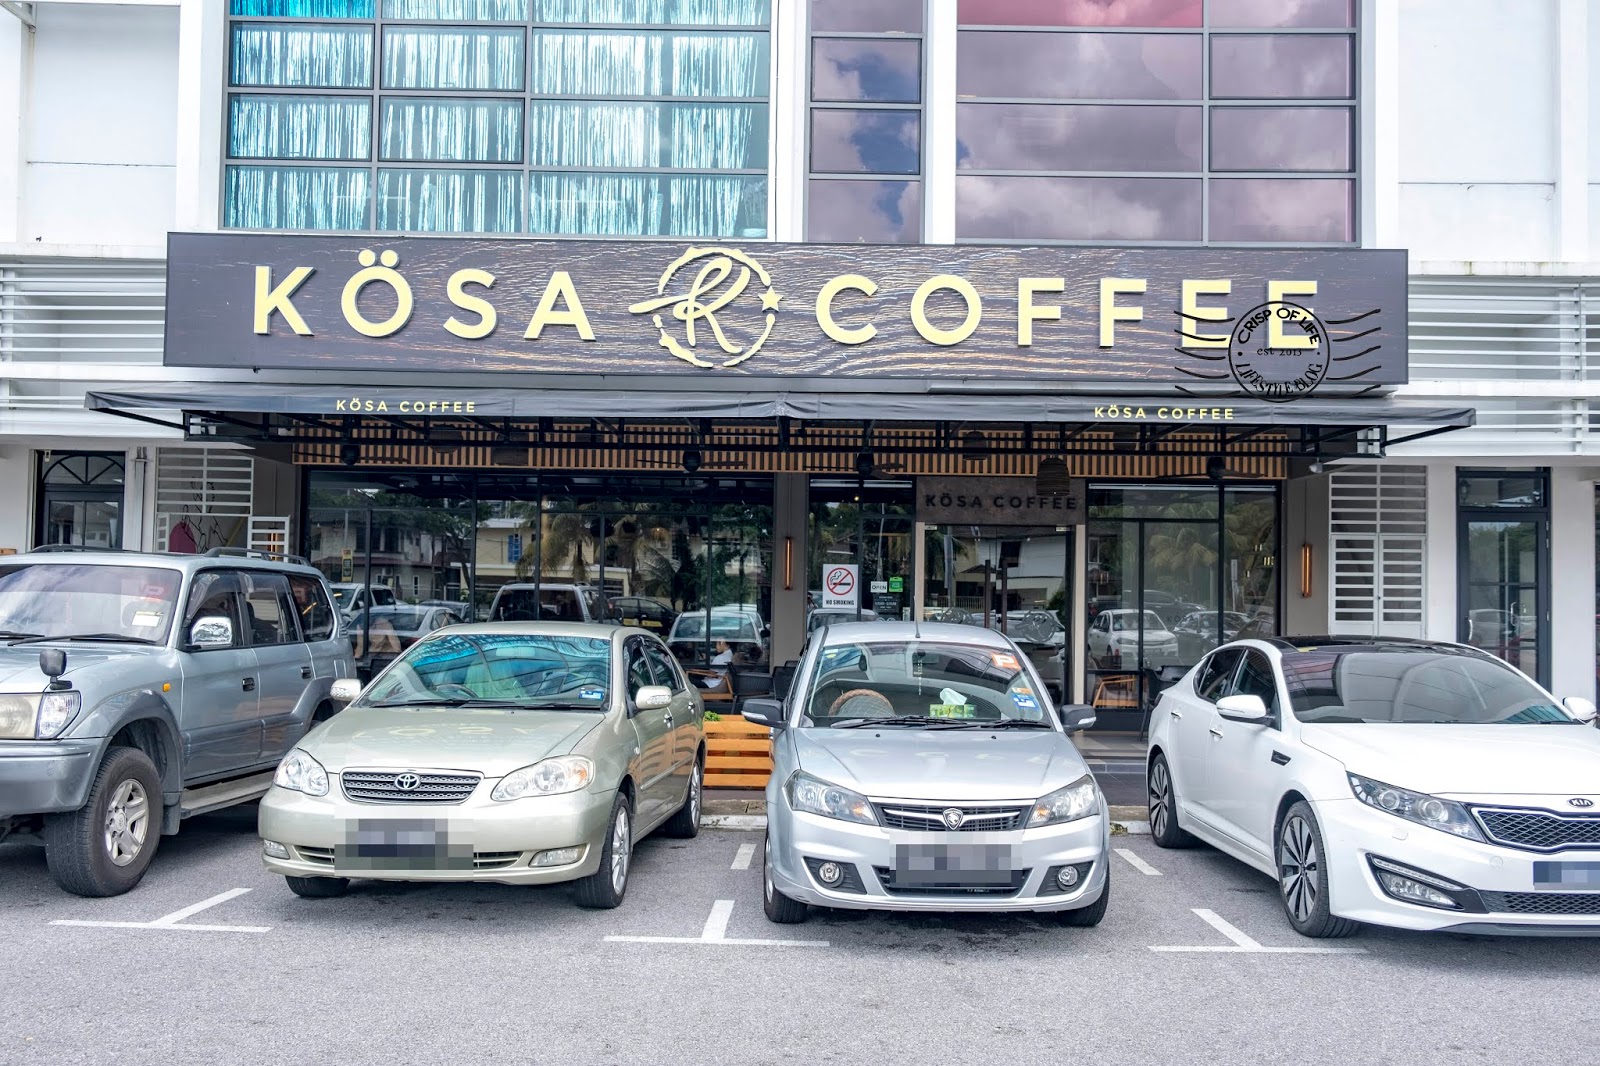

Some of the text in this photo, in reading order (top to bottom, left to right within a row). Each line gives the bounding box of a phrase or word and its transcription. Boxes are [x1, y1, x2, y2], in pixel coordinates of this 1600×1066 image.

[252, 248, 1320, 351] KÖSA COFFEE
[336, 397, 476, 413] KÖSA COFFEE
[1094, 404, 1235, 420] KÖSA COFFEE
[925, 492, 1078, 510] KÖSA COFFEE
[993, 654, 1015, 667] P
